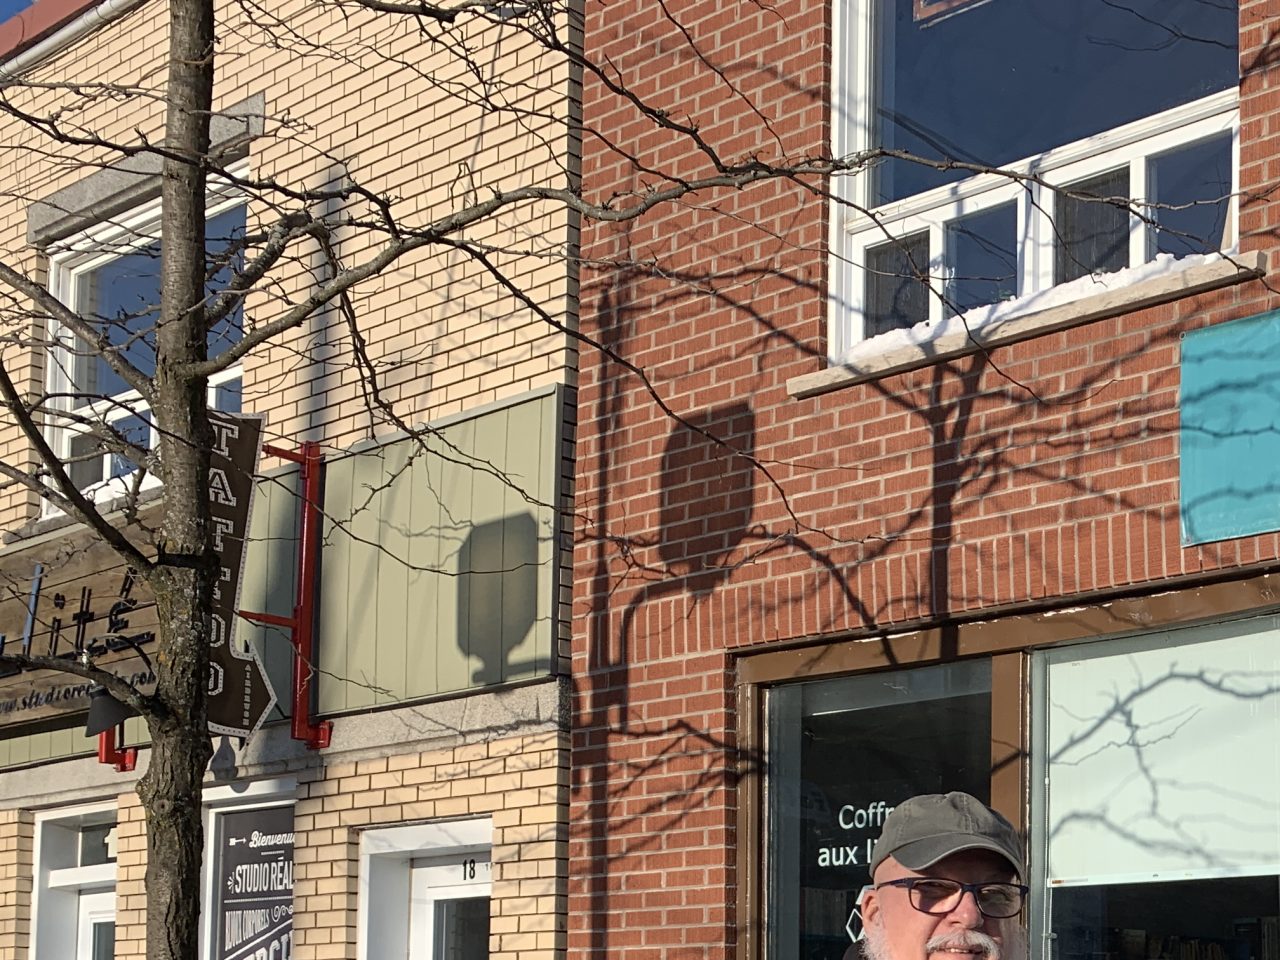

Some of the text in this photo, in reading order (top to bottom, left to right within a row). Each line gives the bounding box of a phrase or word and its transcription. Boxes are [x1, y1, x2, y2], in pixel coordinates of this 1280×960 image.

[818, 845, 858, 867] aux
[235, 863, 270, 894] STUDIO
[463, 859, 476, 881] 18
